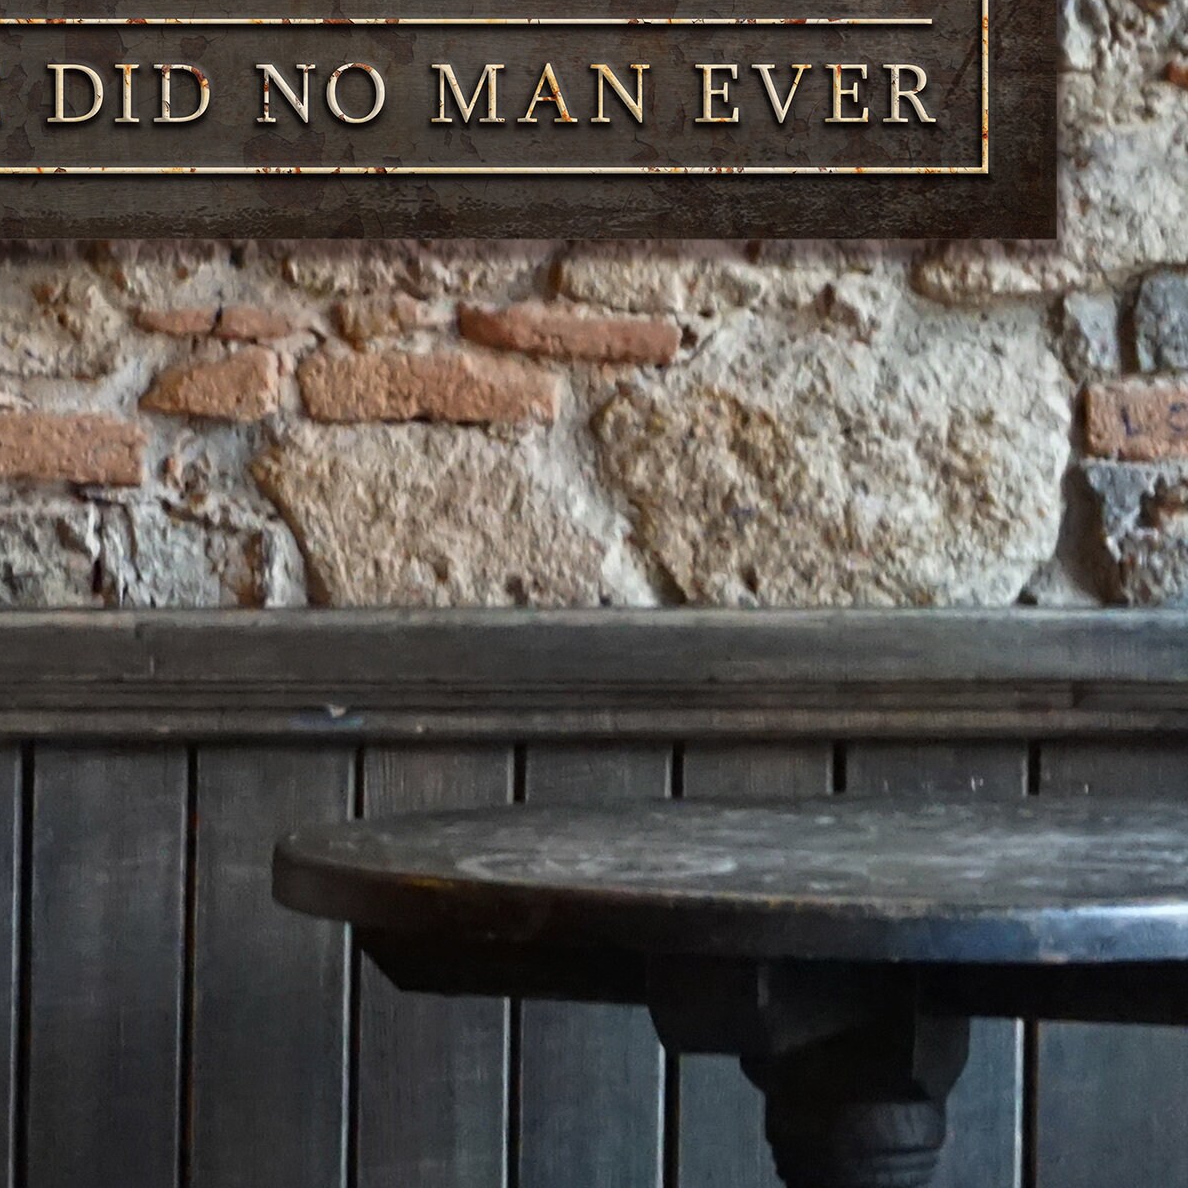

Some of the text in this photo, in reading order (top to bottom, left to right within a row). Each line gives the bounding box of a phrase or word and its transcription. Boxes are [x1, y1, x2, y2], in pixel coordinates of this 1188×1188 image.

[47, 63, 210, 122] DID
[256, 62, 385, 123] NO
[432, 62, 650, 123] MAN
[695, 63, 936, 123] EVER
